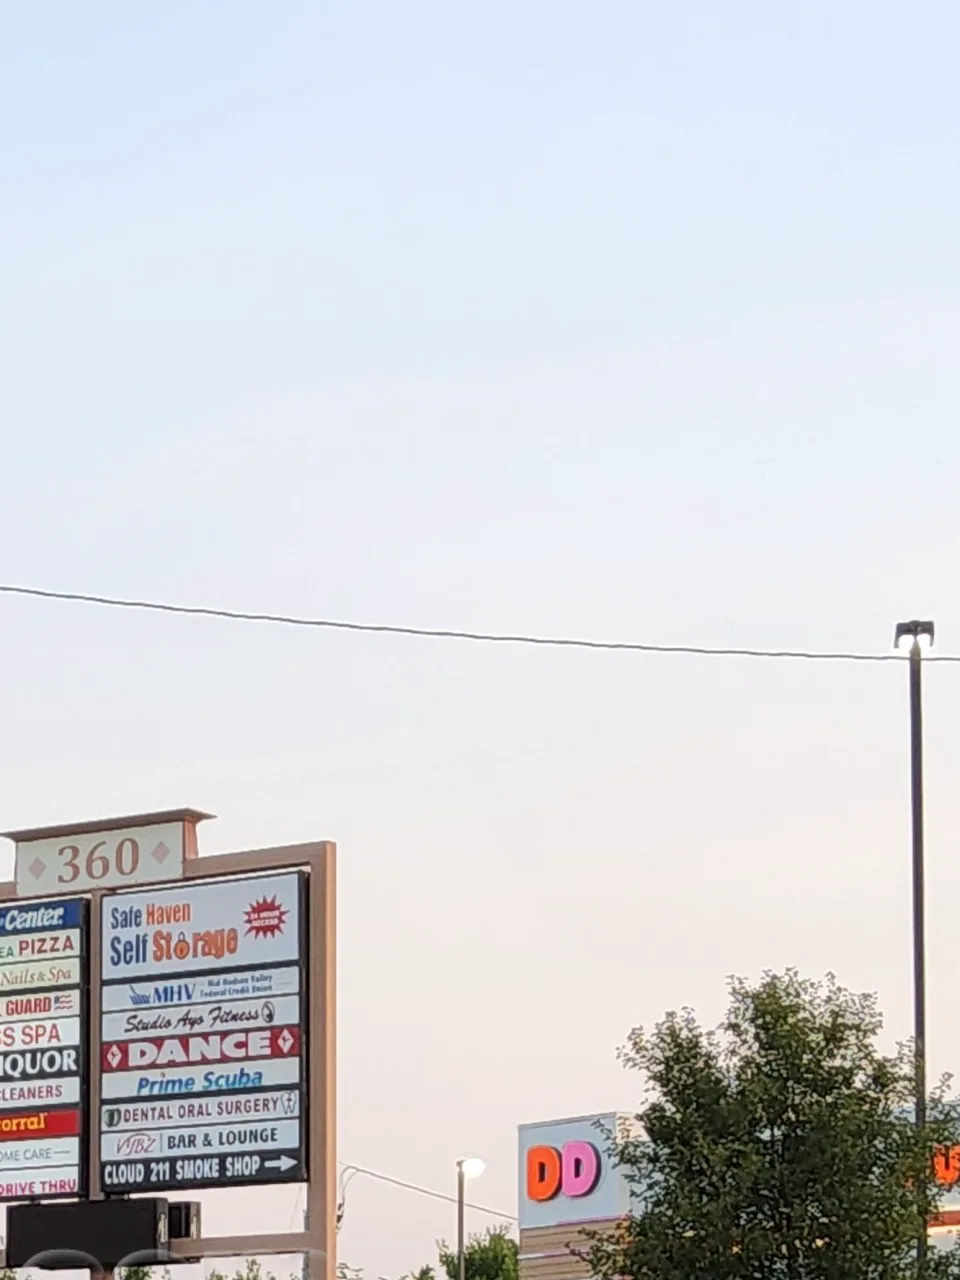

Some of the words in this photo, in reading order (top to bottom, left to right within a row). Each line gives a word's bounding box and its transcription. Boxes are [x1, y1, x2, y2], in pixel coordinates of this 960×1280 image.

[57, 838, 140, 884] 360
[110, 906, 142, 930] Safe
[146, 902, 191, 926] Haven
[19, 935, 74, 956] PIZZA
[110, 933, 148, 966] Self
[152, 928, 238, 963] Storage
[48, 966, 72, 983] Spa
[6, 996, 52, 1016] GUARD
[152, 983, 197, 1005] MHV
[124, 1014, 172, 1033] Studio
[208, 1006, 259, 1028] Fitness
[21, 1023, 61, 1045] SPA
[128, 1030, 272, 1067] DANCE
[137, 1071, 195, 1095] Prime
[202, 1067, 263, 1089] Scuba
[123, 1106, 174, 1123] DENTAL
[177, 1103, 212, 1118] ORAL
[217, 1097, 279, 1116] SURGERY
[167, 1134, 197, 1150] BAR
[202, 1132, 213, 1147] &
[218, 1128, 278, 1145] LOUNGE
[23, 1148, 53, 1160] CARE
[104, 1164, 145, 1185] CLOUD
[150, 1161, 170, 1182] 211
[175, 1158, 220, 1180] SMOKE
[226, 1155, 261, 1176] SHOP
[527, 1140, 602, 1202] DD
[40, 1178, 77, 1193] THRU
